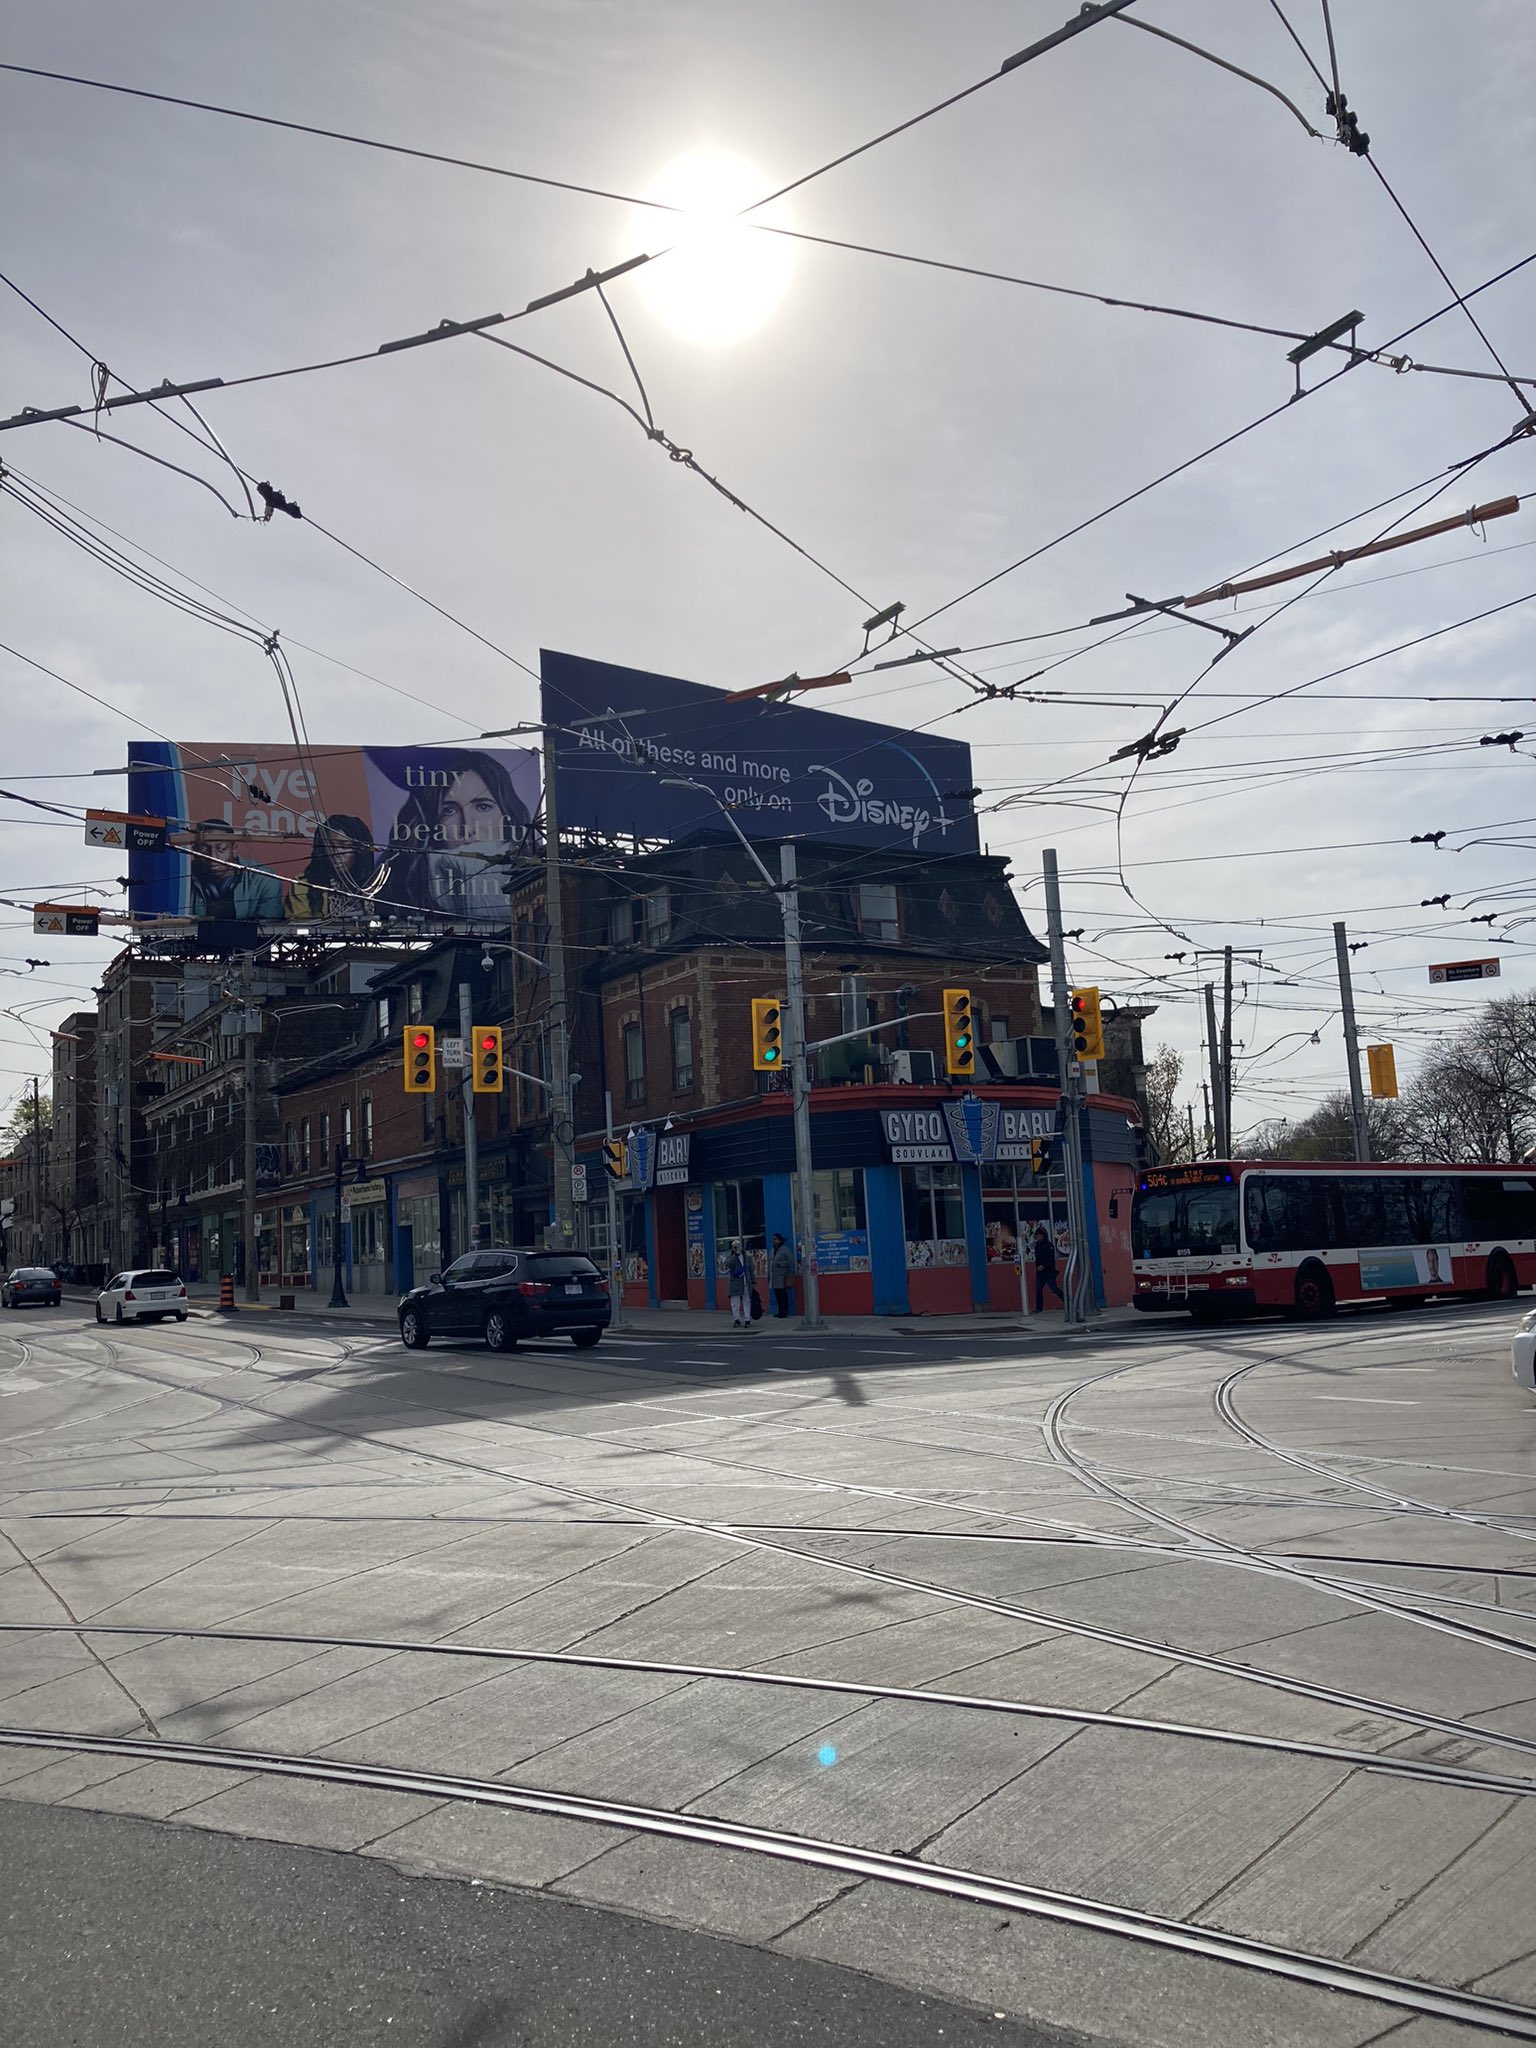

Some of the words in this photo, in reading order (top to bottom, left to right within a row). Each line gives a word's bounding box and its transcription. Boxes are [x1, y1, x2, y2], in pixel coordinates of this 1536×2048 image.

[578, 727, 606, 751] All
[701, 752, 736, 774] and
[742, 760, 790, 783] more
[232, 762, 317, 806] Rye
[404, 765, 468, 796] tiny
[725, 786, 763, 811] only
[769, 793, 792, 812] on
[223, 801, 327, 837] Lane
[388, 814, 529, 842] beautifu
[133, 829, 159, 839] Power
[137, 838, 154, 847] OFF
[72, 917, 93, 925] Power
[443, 1057, 463, 1065] SIGNAL
[887, 1112, 942, 1142] GYRO
[1003, 1111, 1050, 1140] BAR!
[660, 1137, 688, 1166] BAR!
[895, 1148, 949, 1159] SOUVLAKI
[1000, 1146, 1031, 1156] KITCH
[659, 1170, 686, 1182] KITCHEN
